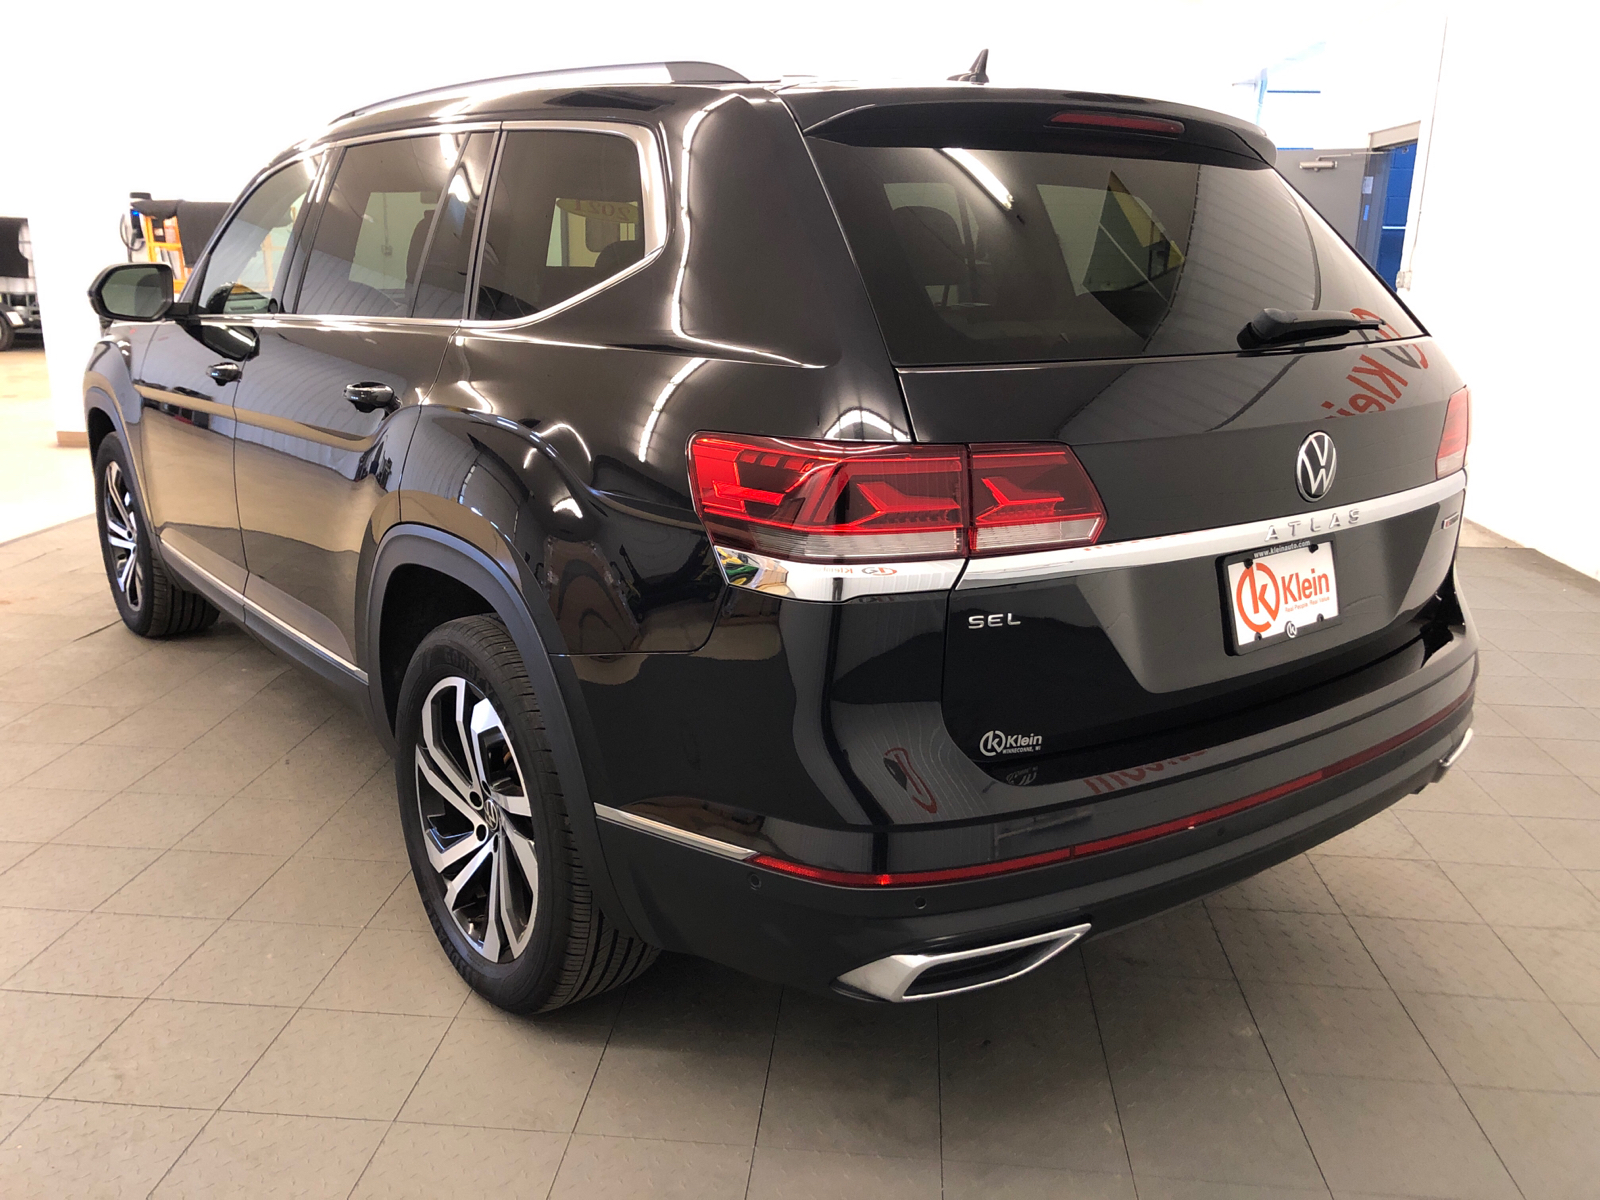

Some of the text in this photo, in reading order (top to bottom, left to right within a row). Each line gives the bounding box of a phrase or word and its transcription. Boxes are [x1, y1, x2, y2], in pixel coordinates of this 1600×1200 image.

[1264, 508, 1361, 542] ATLAS
[1253, 540, 1312, 559] www.kleinauto.com
[1281, 568, 1331, 605] Klein
[968, 612, 1022, 630] SEL
[1006, 733, 1043, 748] Klein
